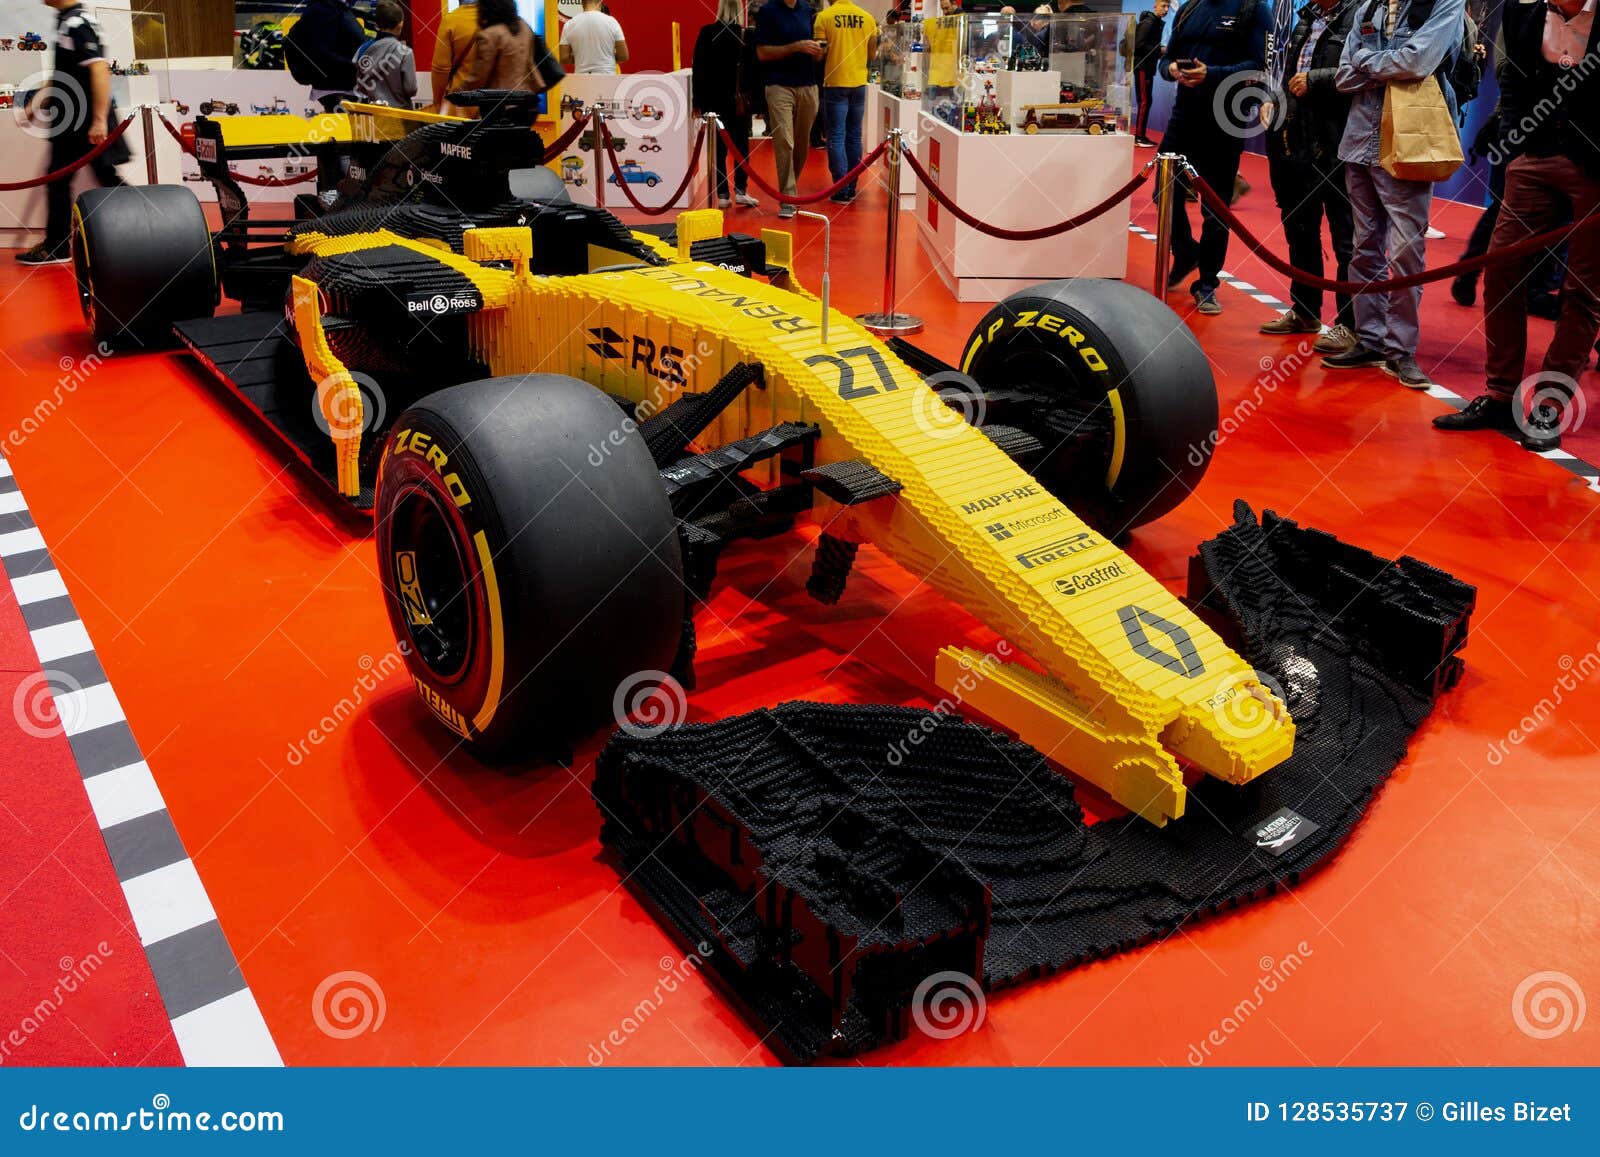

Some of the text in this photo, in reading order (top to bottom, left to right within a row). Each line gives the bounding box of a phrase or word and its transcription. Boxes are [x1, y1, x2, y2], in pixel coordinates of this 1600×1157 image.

[834, 14, 864, 29] STAFF
[353, 113, 380, 144] HUL
[440, 141, 472, 160] MAPFRE
[407, 300, 429, 312] Bell
[450, 298, 478, 309] Ross
[632, 269, 820, 335] RENAULT
[987, 310, 1109, 372] P ZERO
[803, 345, 900, 401] 27
[394, 428, 472, 507] ZERO
[961, 484, 1041, 515] MAPFRE
[1008, 507, 1068, 532] Microsoft
[1015, 532, 1099, 569] PIRELLI
[1072, 560, 1127, 590] Castrol
